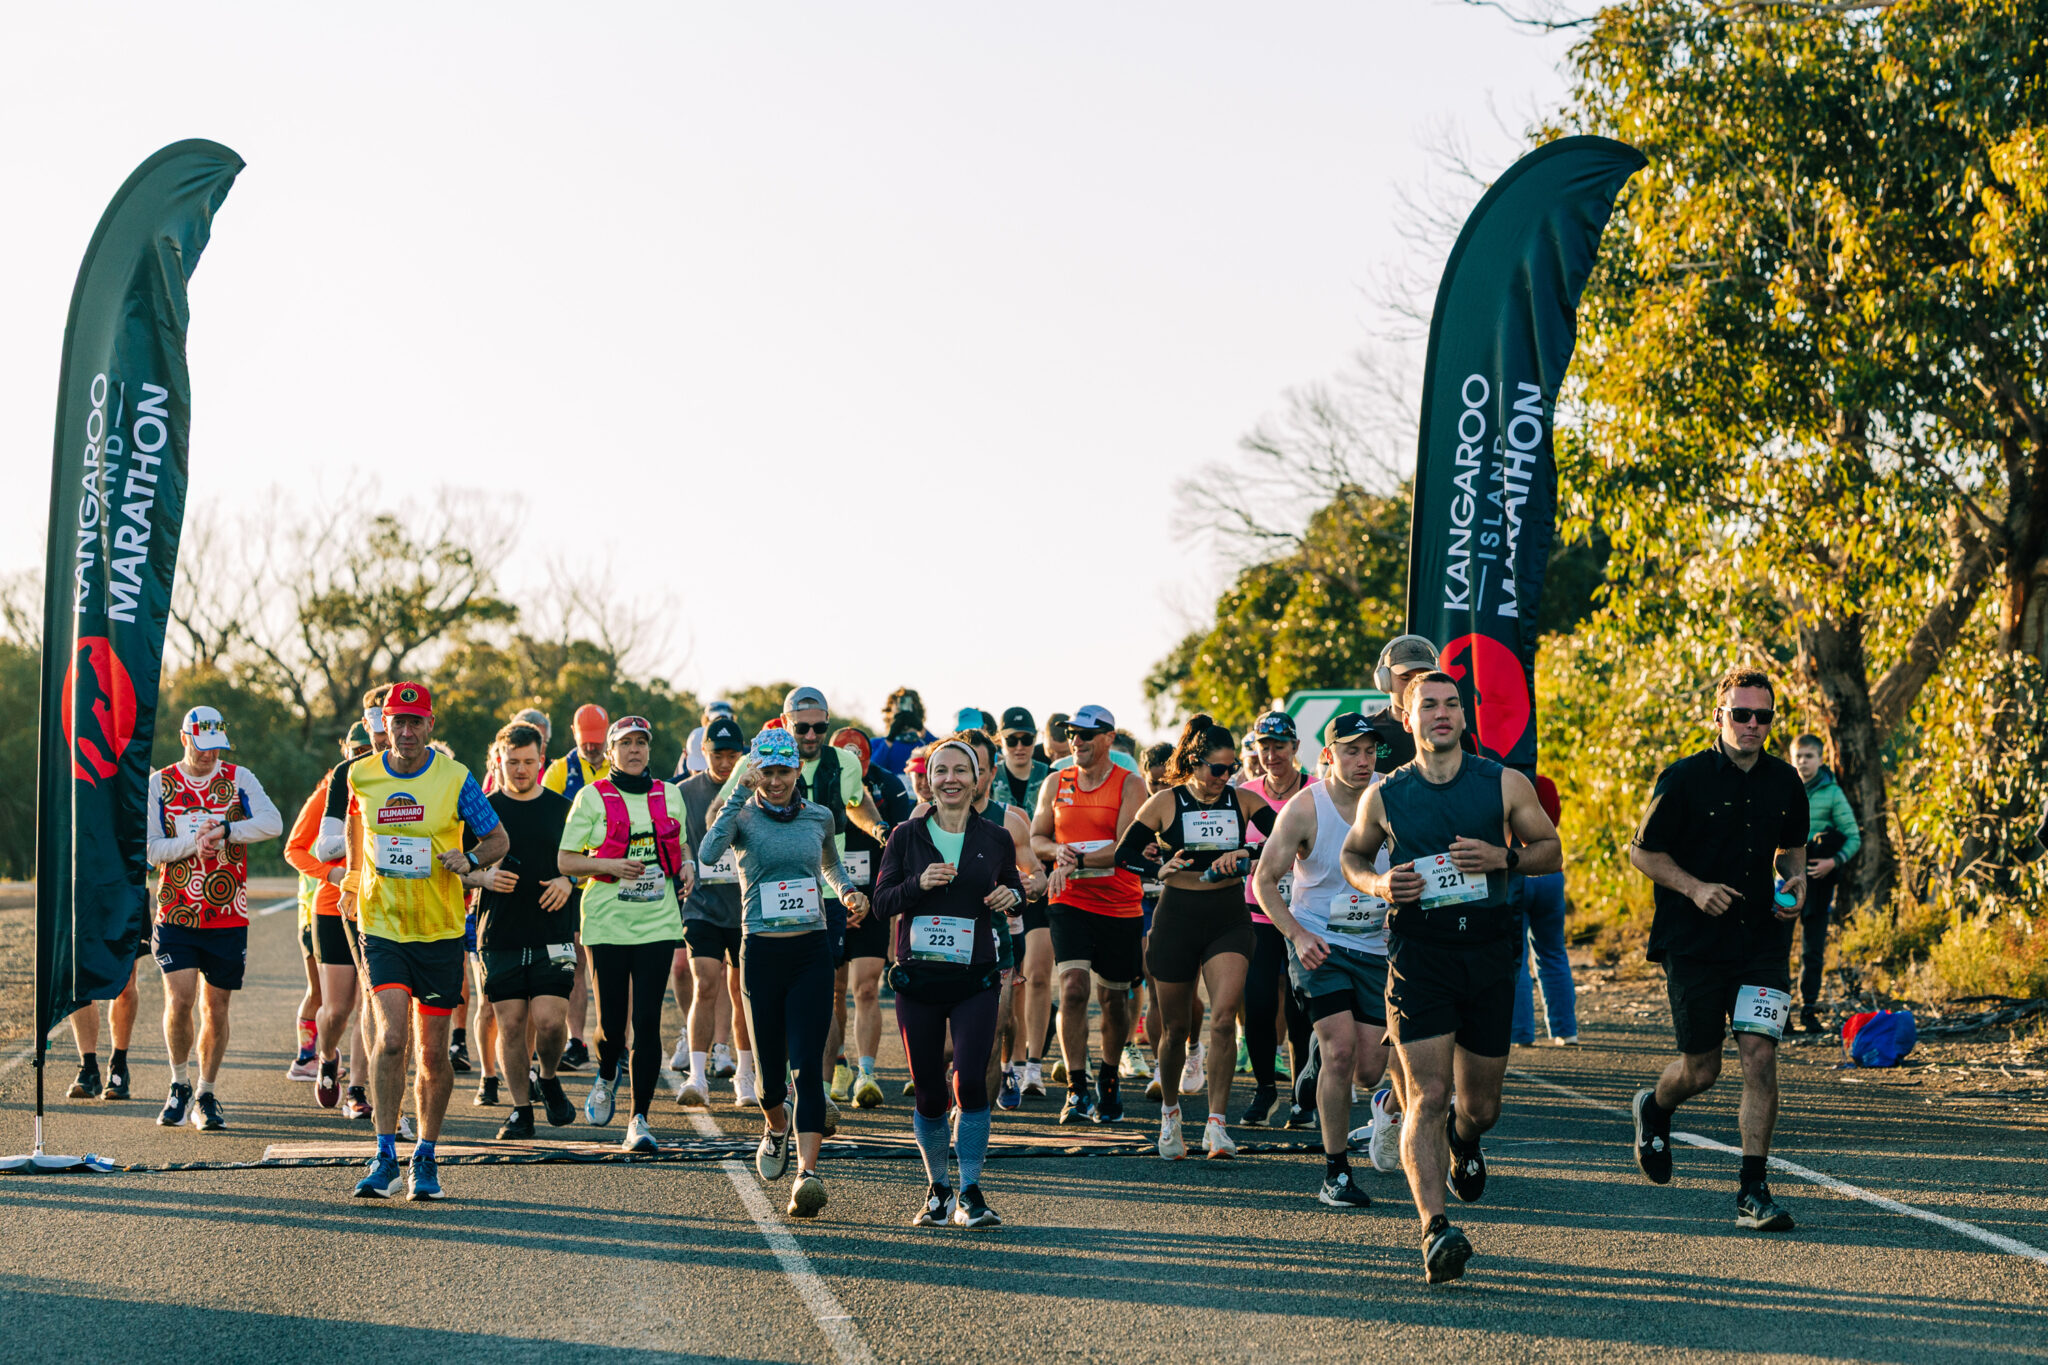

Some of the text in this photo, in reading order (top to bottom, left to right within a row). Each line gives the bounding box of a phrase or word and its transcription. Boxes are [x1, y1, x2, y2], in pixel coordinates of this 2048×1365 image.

[73, 372, 108, 613] KANGAROO
[102, 434, 124, 562] SLAND
[1443, 373, 1490, 611] KANGAROO
[1477, 434, 1504, 560] ISLAND
[108, 382, 169, 624] MARATHON
[379, 807, 422, 818] KILIMANJARO
[1201, 826, 1224, 837] 219
[389, 854, 413, 865] 248
[712, 863, 731, 873] 234
[844, 865, 857, 874] 35
[1432, 866, 1453, 875] ANTON
[635, 881, 655, 892] 205
[1437, 872, 1465, 889] 221
[1278, 884, 1290, 894] 51
[780, 897, 804, 910] 222
[1346, 911, 1371, 921] 236
[929, 934, 955, 947] 223
[1753, 1005, 1778, 1020] 258
